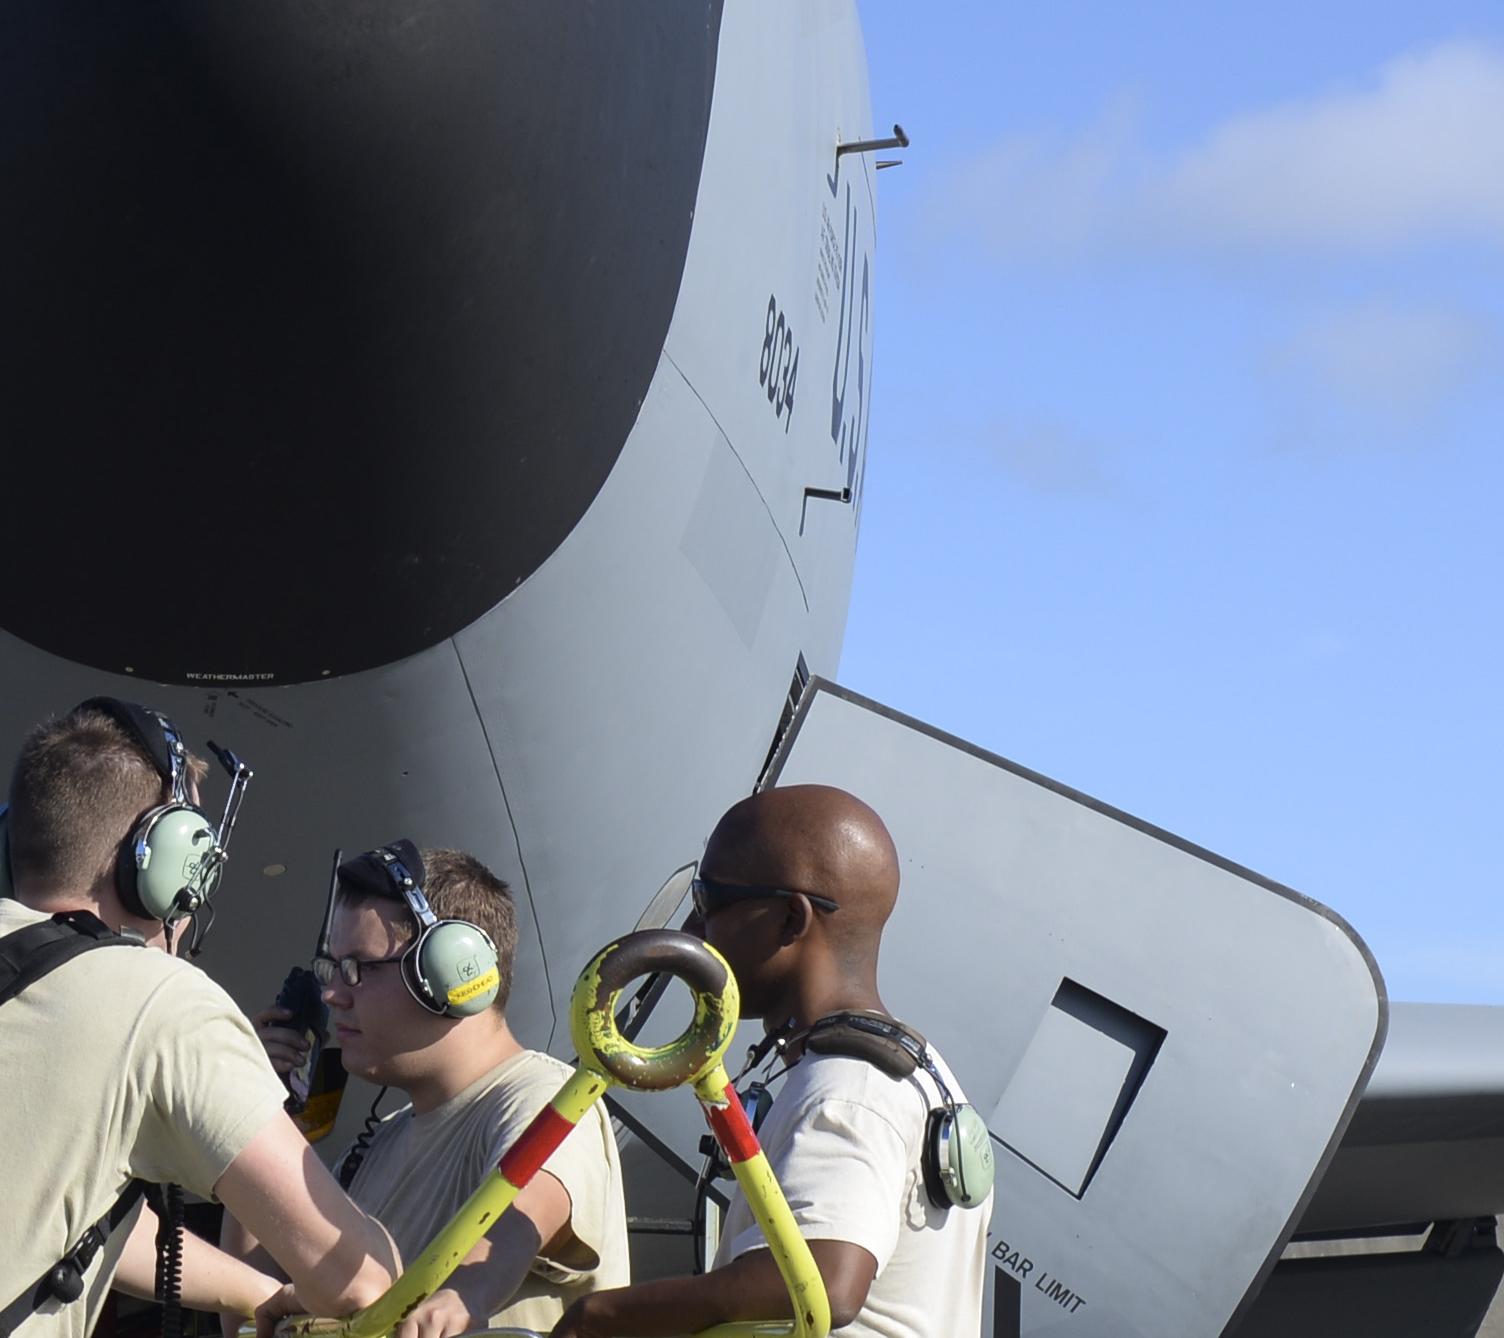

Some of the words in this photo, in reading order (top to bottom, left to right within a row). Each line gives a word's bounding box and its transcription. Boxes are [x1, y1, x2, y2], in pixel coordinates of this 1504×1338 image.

[759, 294, 799, 434] 8034
[991, 1240, 1034, 1279] BAR
[1034, 1272, 1087, 1314] LIMIT
